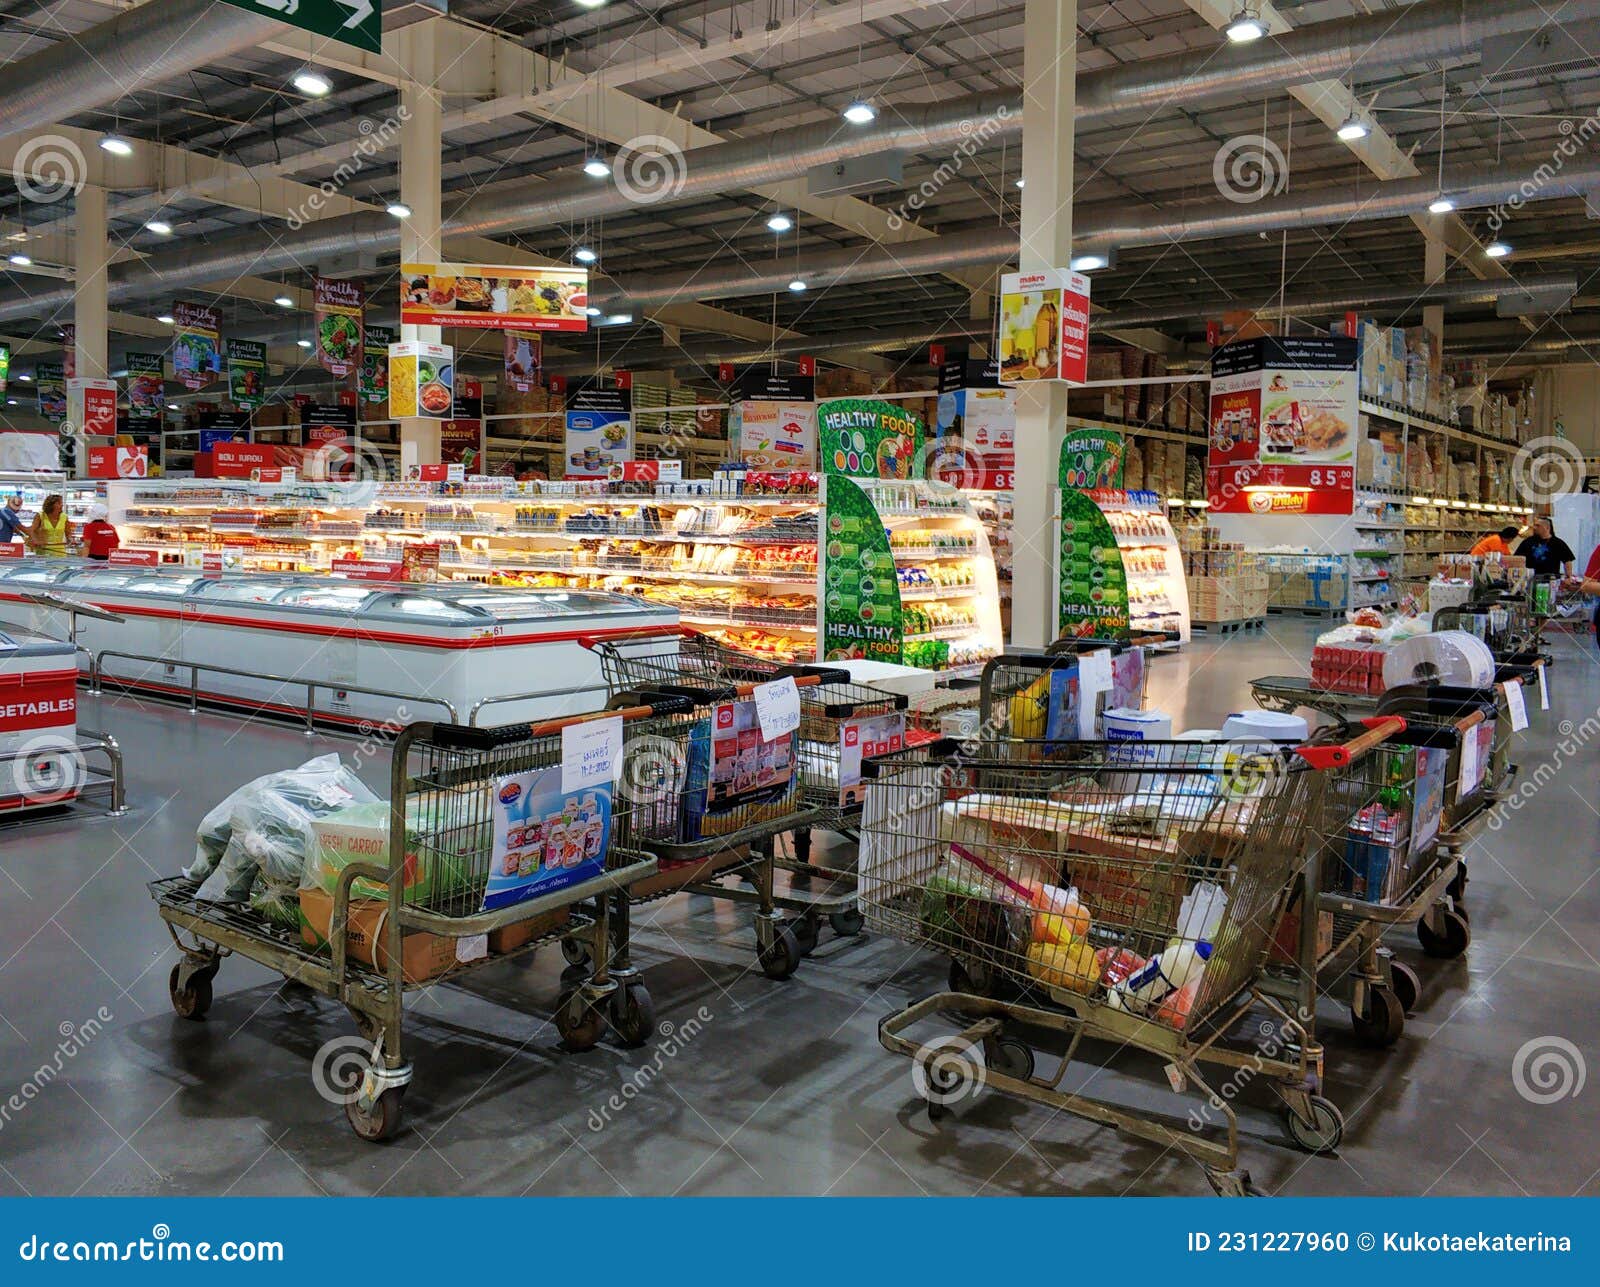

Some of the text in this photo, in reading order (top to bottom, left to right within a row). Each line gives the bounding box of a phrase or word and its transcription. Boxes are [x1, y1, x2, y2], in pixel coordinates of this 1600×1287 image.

[801, 363, 808, 375] 5
[617, 377, 624, 387] 7
[825, 411, 877, 430] HEALTHY
[881, 414, 915, 437] FOOD
[1067, 438, 1106, 453] HEALTHY
[1062, 604, 1121, 617] HEALTHY
[1100, 617, 1126, 627] FOOD
[493, 626, 504, 636] 61
[828, 623, 894, 640] HEALTHY
[870, 642, 899, 654] FOOD
[348, 836, 385, 856] CARROT
